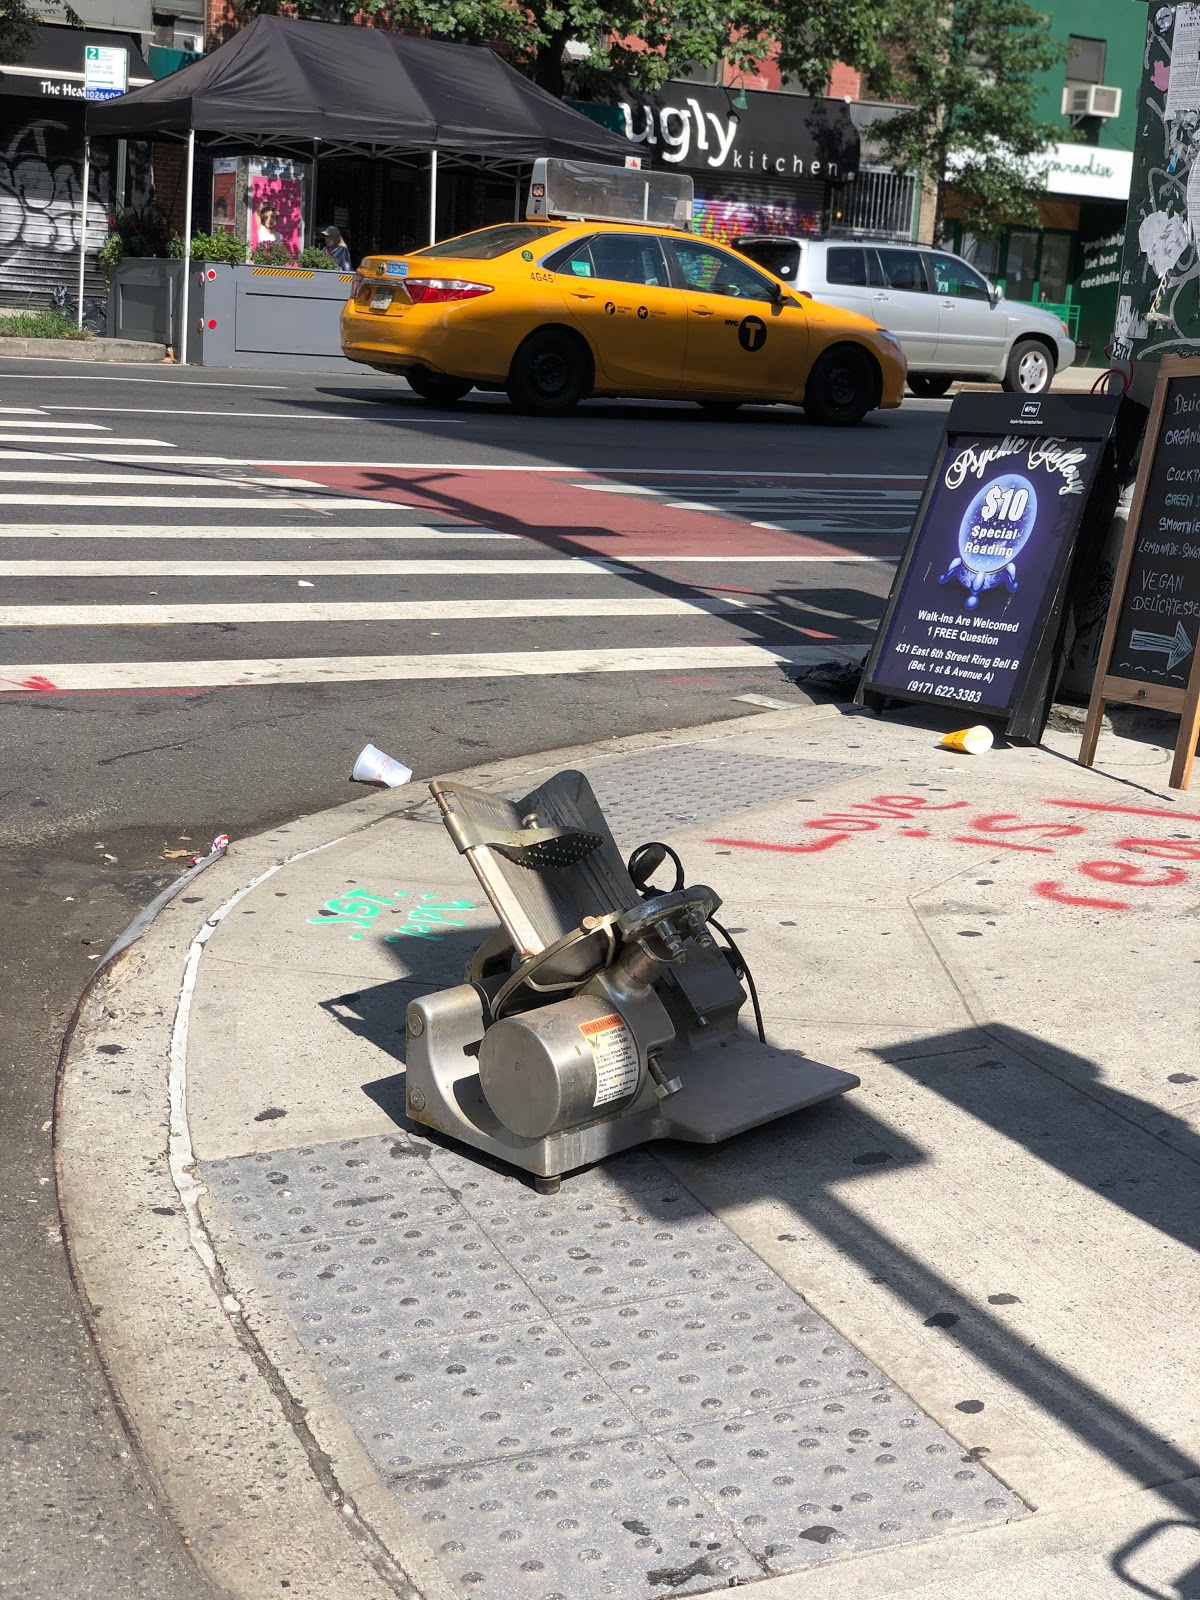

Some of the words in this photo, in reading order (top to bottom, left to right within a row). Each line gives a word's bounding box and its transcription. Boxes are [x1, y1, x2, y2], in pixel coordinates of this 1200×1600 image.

[89, 48, 97, 59] 2
[40, 81, 60, 96] The
[617, 98, 738, 168] ugly
[266, 163, 290, 172] Phone
[733, 149, 838, 177] kitchen
[1042, 153, 1114, 178] paradise
[1085, 259, 1098, 269] the
[1100, 252, 1118, 266] best
[1081, 271, 1120, 288] cocktails
[724, 318, 739, 327] NYC
[945, 436, 1028, 489] Psychic
[1028, 437, 1087, 495] Gallery
[981, 485, 1029, 521] $10
[1165, 493, 1194, 508] GREEN
[972, 525, 1018, 540] Special
[964, 542, 1014, 558] Reading
[1142, 569, 1185, 593] VEGAN
[918, 610, 953, 624] Walk-Ins
[955, 615, 970, 626] Are
[973, 617, 1019, 633] Welcomed
[928, 626, 932, 635] 1
[934, 627, 958, 639] FREE
[960, 631, 998, 645] Question
[895, 643, 910, 653] 431
[911, 645, 930, 657] East
[931, 649, 944, 659] 6th
[945, 651, 970, 663] Street
[971, 655, 991, 668] Ring
[992, 658, 1010, 669] Bell
[1011, 660, 1019, 670] B
[908, 660, 926, 671] (Bet.
[944, 666, 951, 674] &
[952, 667, 982, 680] Avenue
[983, 672, 995, 683] A)
[907, 680, 933, 694] (917)
[935, 685, 982, 703] 622-3383
[702, 794, 969, 854] Love
[591, 1015, 621, 1030] WARNING
